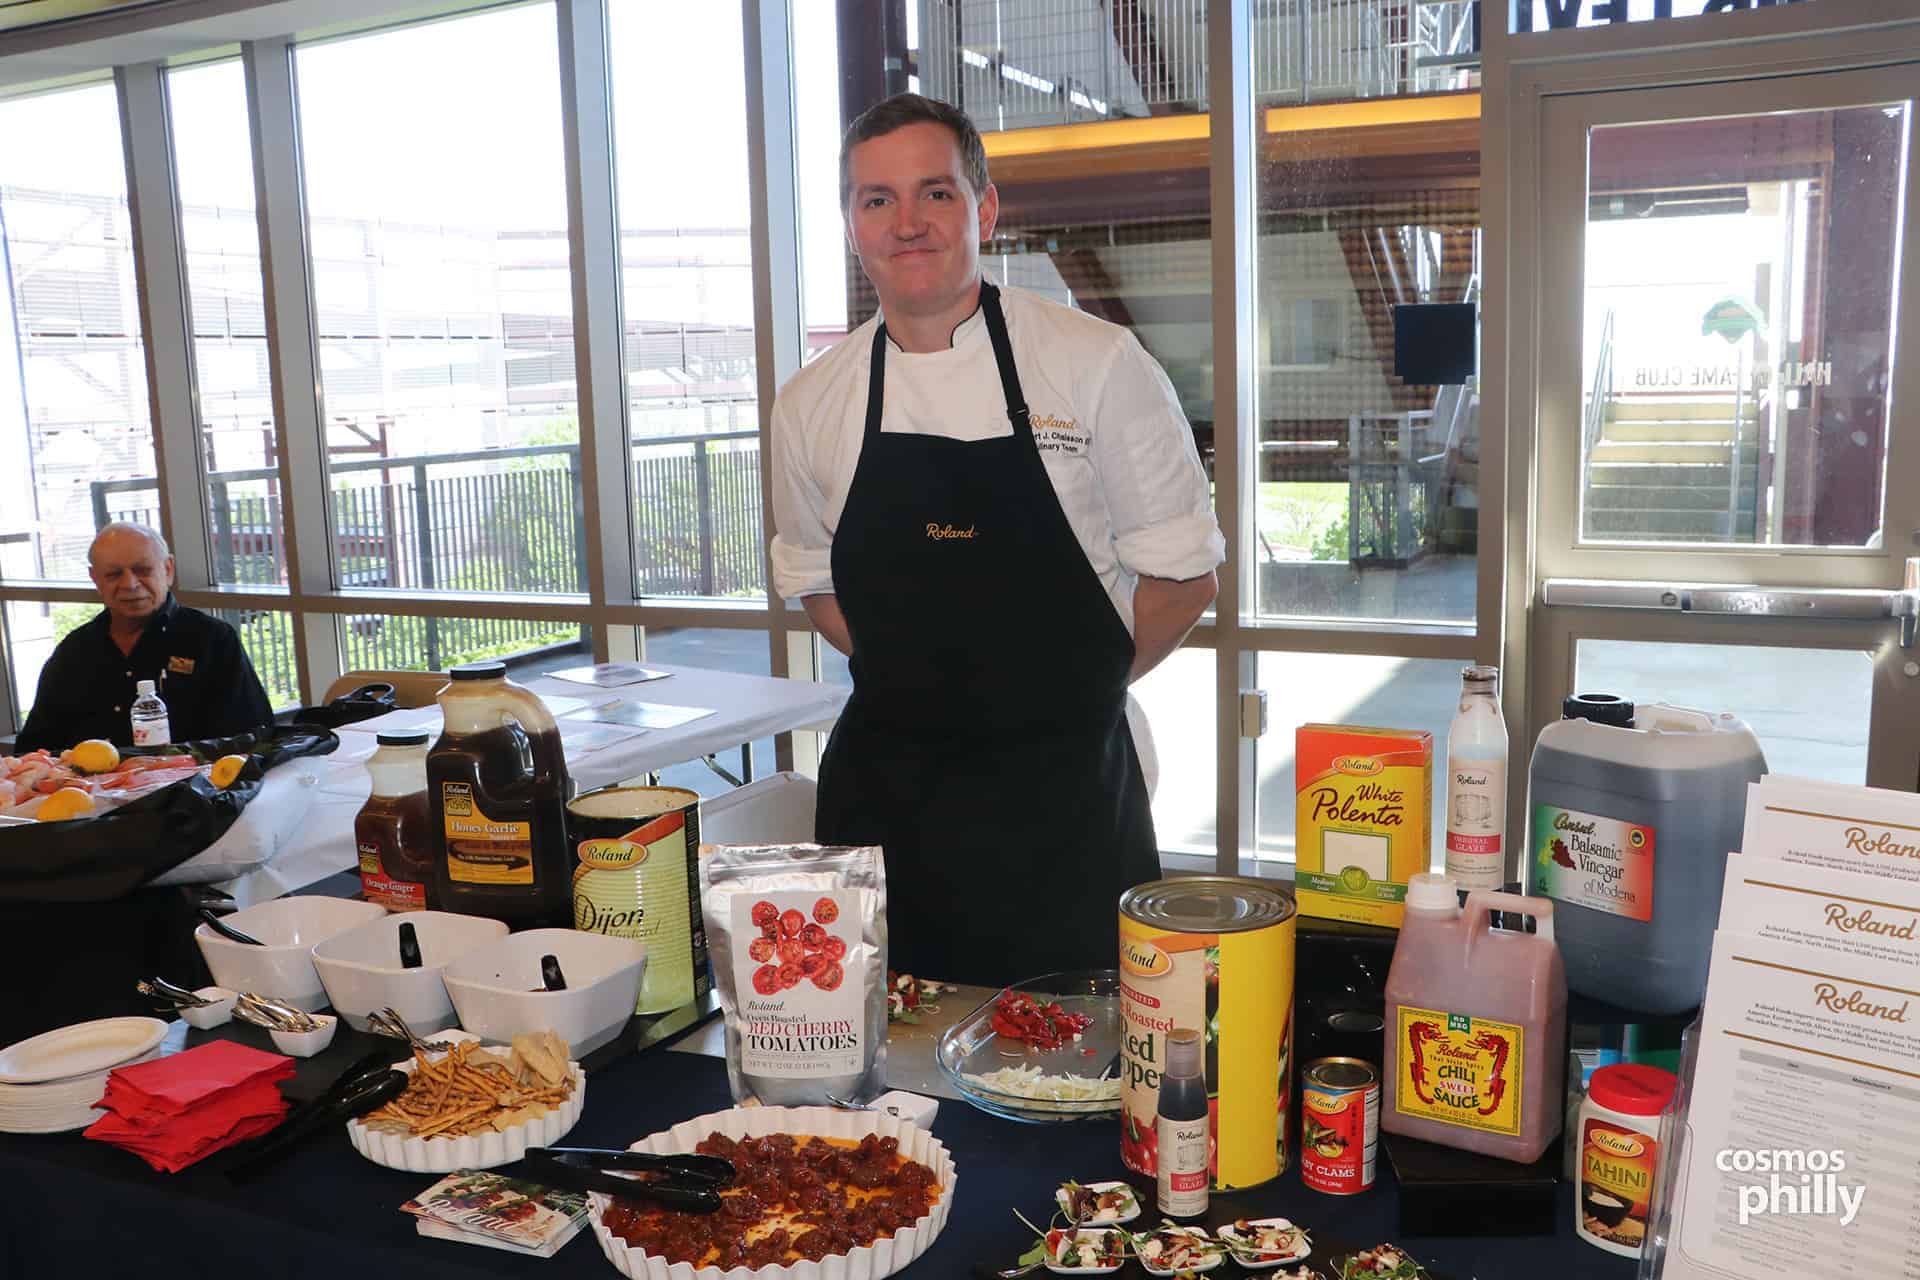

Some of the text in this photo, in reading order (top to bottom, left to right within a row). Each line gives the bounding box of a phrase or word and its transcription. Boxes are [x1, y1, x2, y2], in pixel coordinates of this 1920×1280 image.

[1030, 414, 1076, 430] Roland
[926, 522, 975, 540] Roland
[1341, 758, 1374, 771] Roland
[1456, 774, 1488, 786] Roland
[1357, 781, 1404, 803] White
[1311, 787, 1404, 826] Polenta
[451, 821, 519, 834] Honey Garlic
[585, 846, 634, 862] Roland
[1455, 843, 1488, 852] GLAZE
[1570, 834, 1623, 861] Balsamic
[1578, 853, 1625, 883] Vinegar
[1583, 878, 1596, 895] of
[1598, 881, 1636, 904] Modena
[576, 894, 645, 935] Dijon
[1824, 903, 1917, 940] Roland
[747, 1000, 785, 1012] Roland
[1814, 982, 1909, 1023] Roland
[1126, 1003, 1174, 1033] Roasted
[1449, 1022, 1468, 1031] MSG
[1453, 1015, 1465, 1023] NO
[749, 1020, 853, 1038] RED CHERRY
[747, 1033, 857, 1053] TOMATOES
[1120, 1015, 1157, 1063] Red
[1437, 1043, 1479, 1062] Roland
[1437, 1065, 1476, 1085] CHILI
[1439, 1080, 1475, 1094] SWEET
[1433, 1086, 1480, 1109] SAUCE
[1176, 1128, 1204, 1141] Roland
[1598, 1134, 1634, 1152] Roland
[1316, 1165, 1356, 1178] CLAMS
[1586, 1152, 1648, 1188] TAHINI
